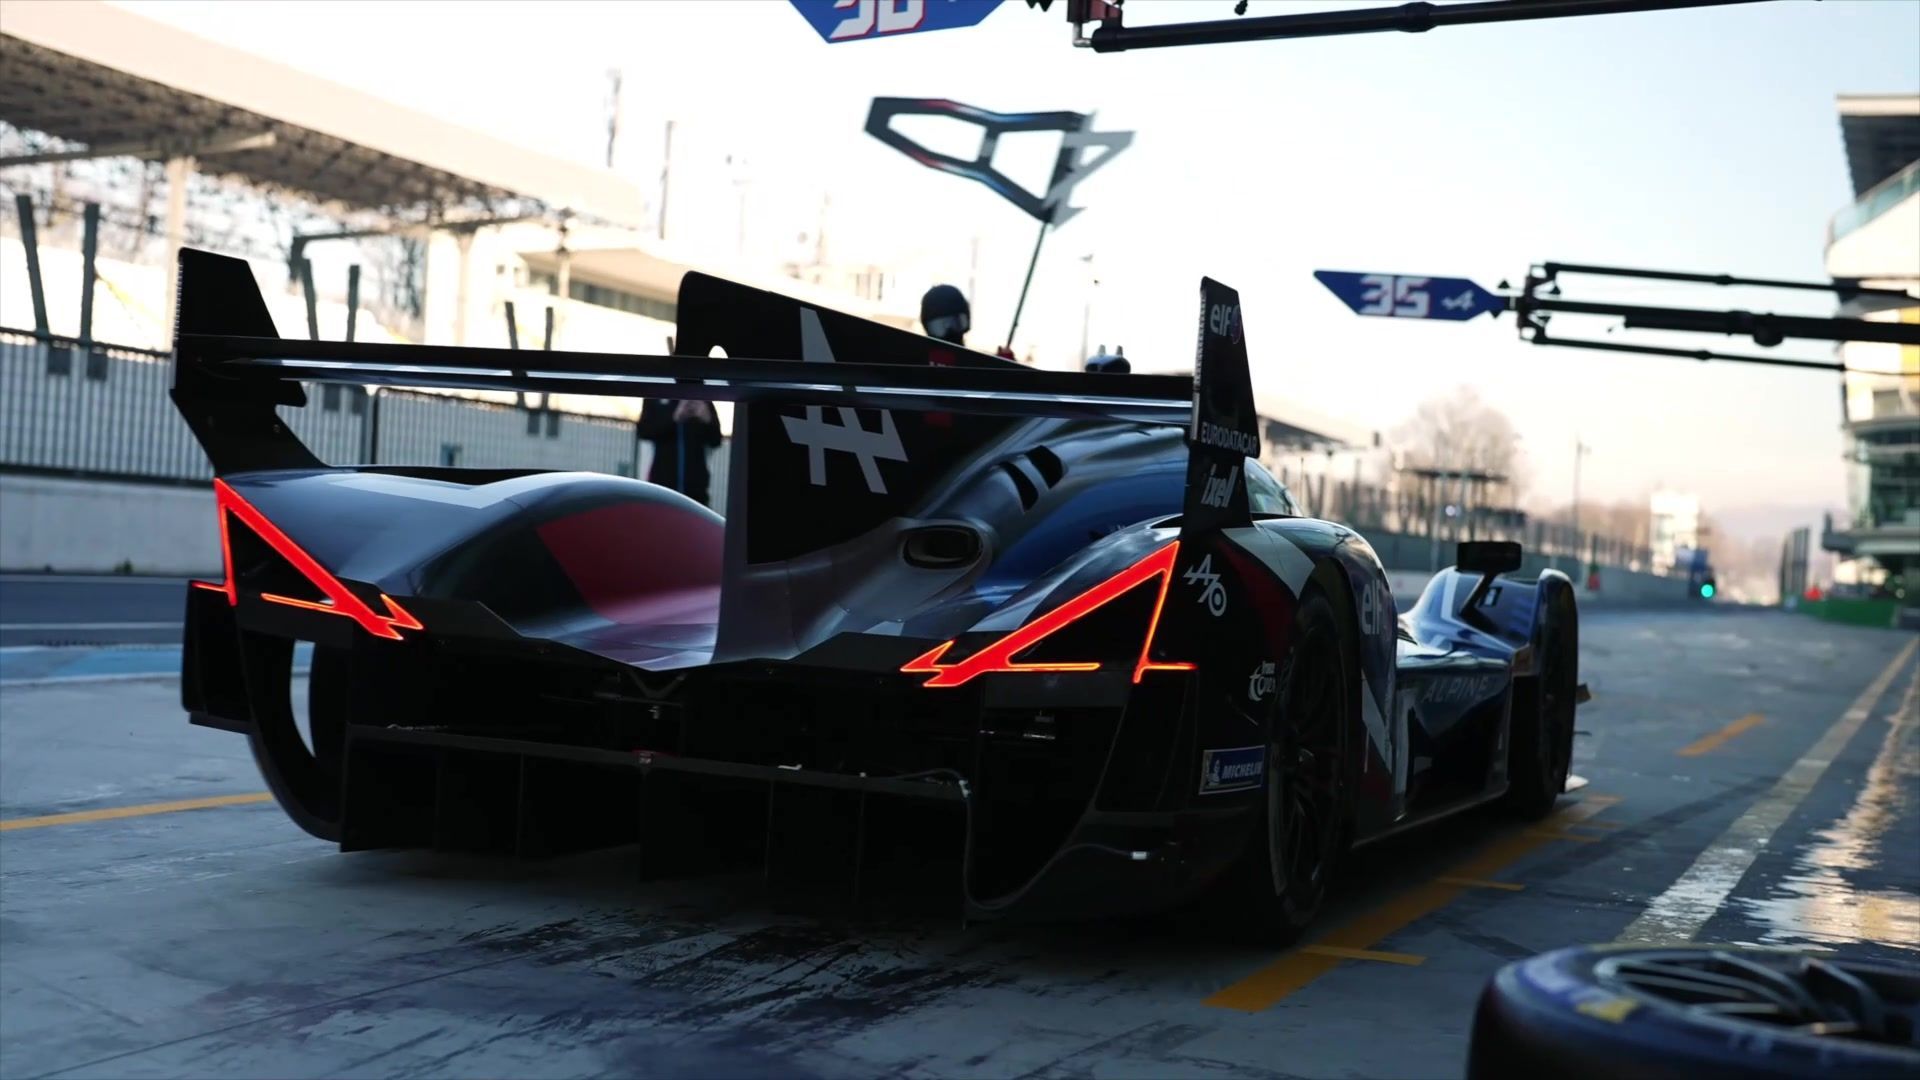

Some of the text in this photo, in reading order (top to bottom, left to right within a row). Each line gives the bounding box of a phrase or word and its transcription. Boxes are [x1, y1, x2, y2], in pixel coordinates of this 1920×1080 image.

[1358, 274, 1431, 318] 35
[1210, 303, 1232, 337] elf
[1221, 761, 1263, 779] MICHELIN
